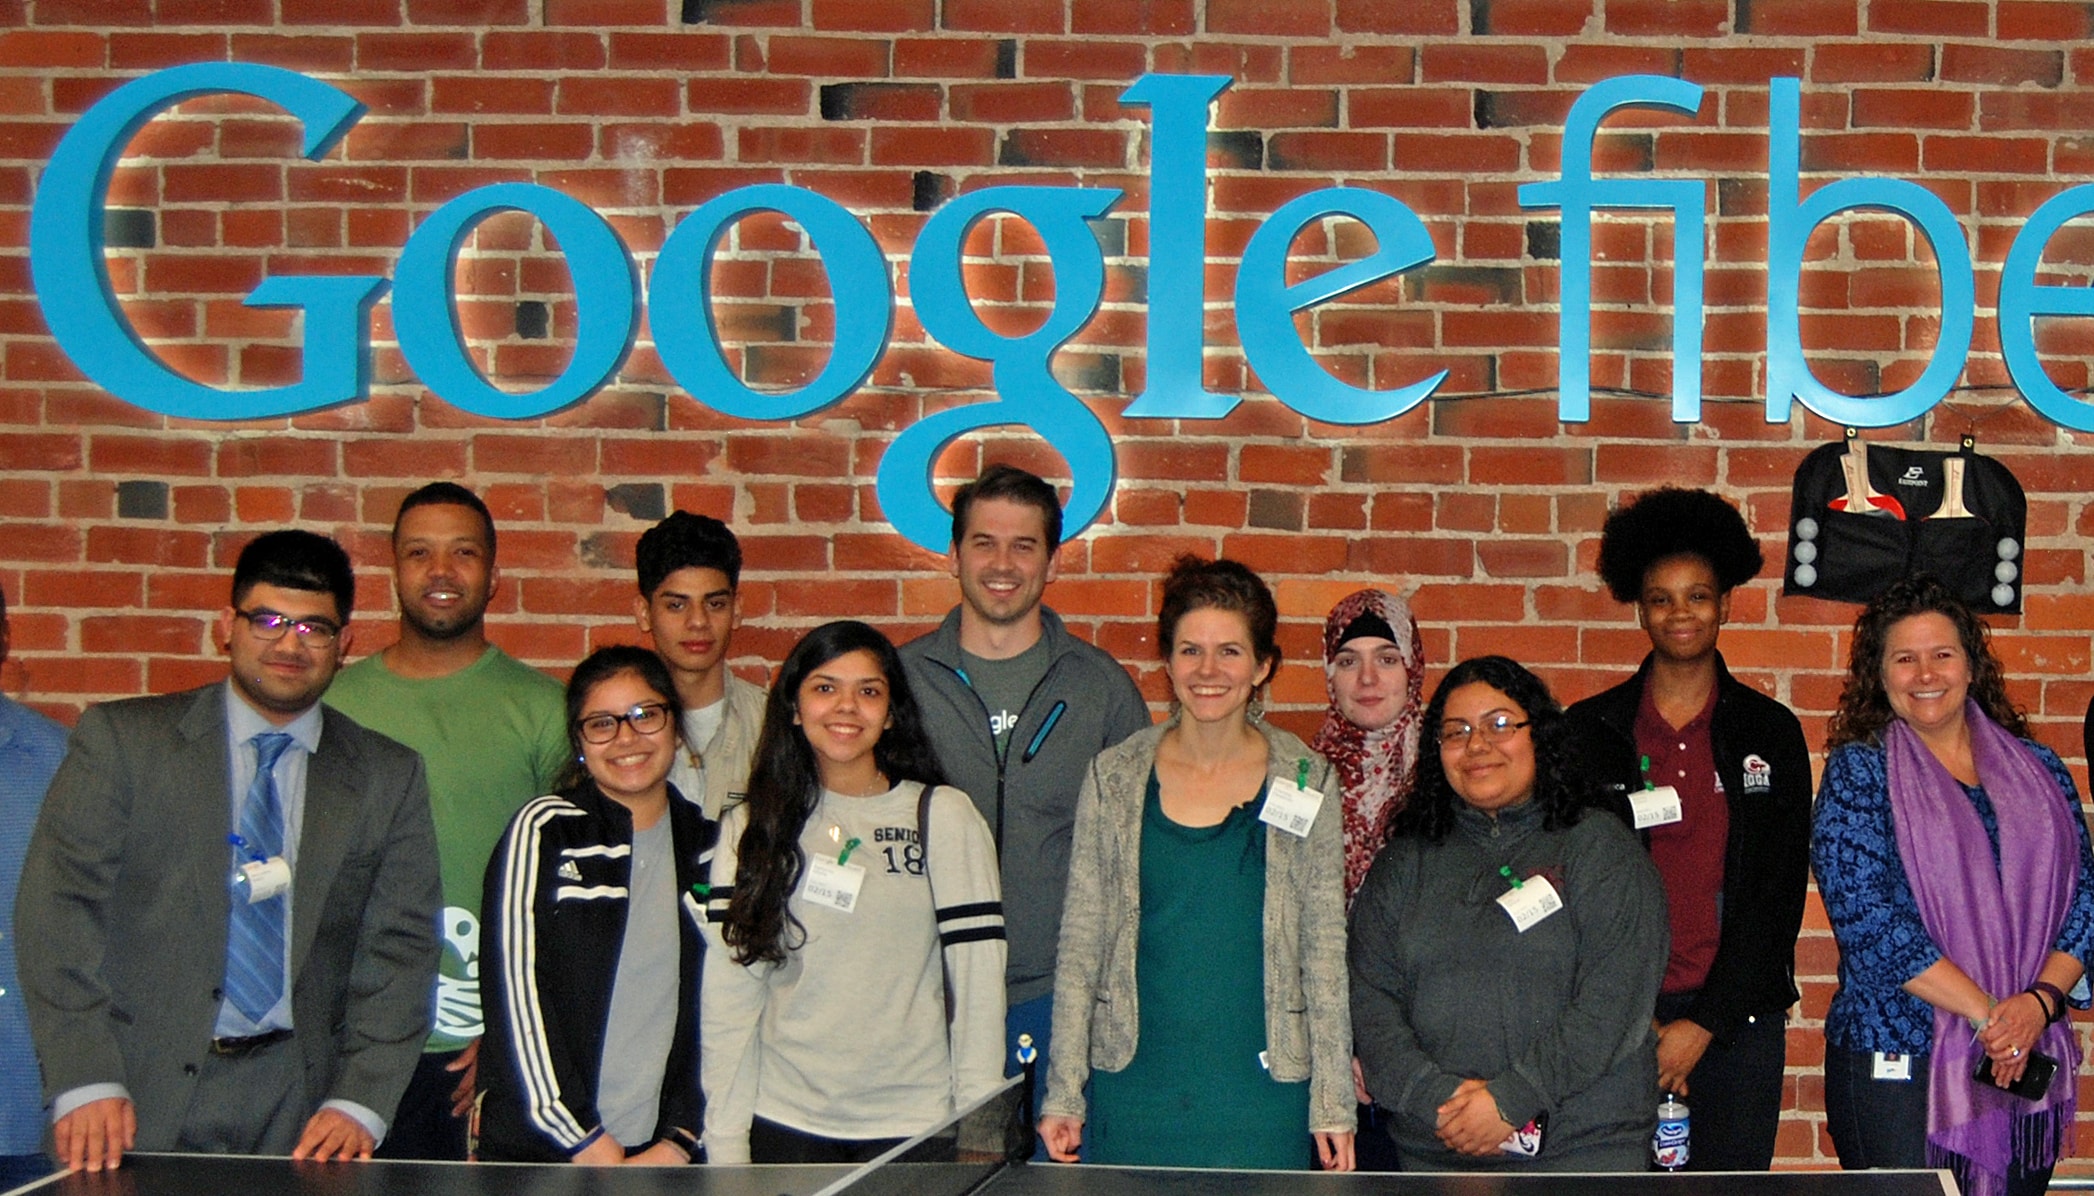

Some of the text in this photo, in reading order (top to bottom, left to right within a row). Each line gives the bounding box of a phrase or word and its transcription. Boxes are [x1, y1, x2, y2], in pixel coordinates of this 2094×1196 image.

[29, 62, 1449, 556] Google
[990, 709, 1018, 735] gle
[874, 827, 920, 844] SENIO
[882, 845, 924, 875] 18
